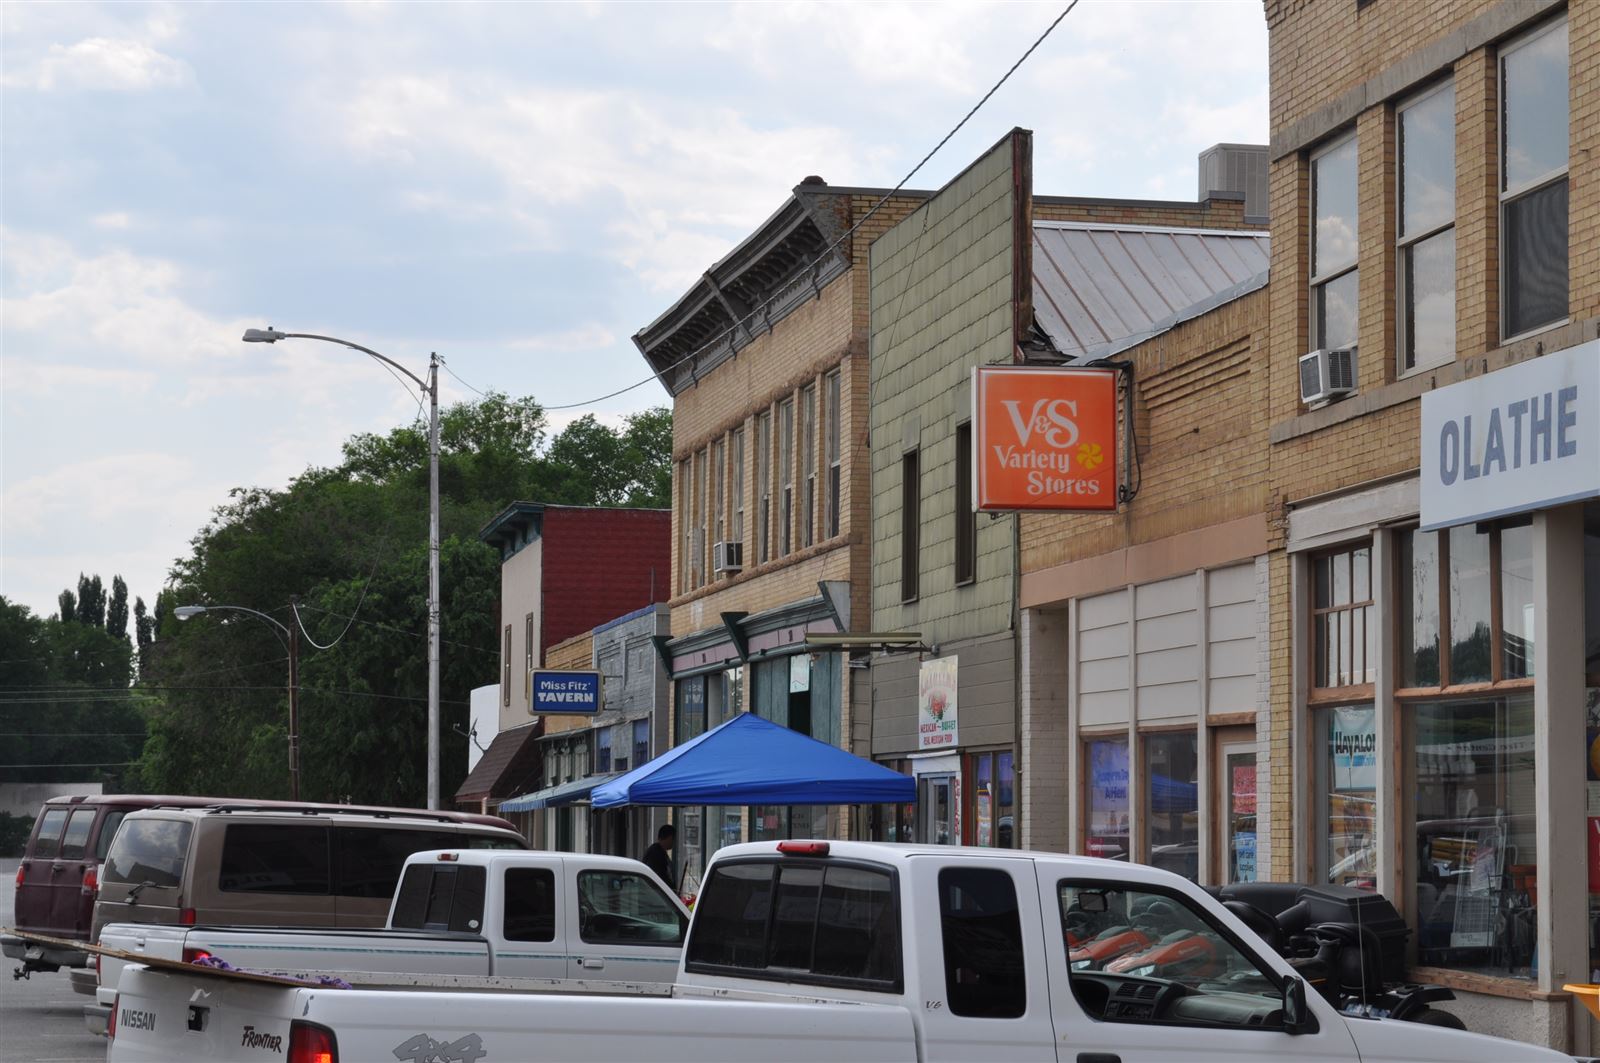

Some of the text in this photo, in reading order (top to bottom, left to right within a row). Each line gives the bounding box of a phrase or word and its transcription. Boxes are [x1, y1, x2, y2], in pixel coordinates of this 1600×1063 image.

[1000, 398, 1079, 449] V&S
[1439, 384, 1578, 487] OLATHE
[992, 444, 1071, 474] Variety
[1026, 470, 1100, 496] Stores
[537, 692, 594, 703] TAVERN
[540, 681, 567, 690] Miss
[941, 720, 956, 731] BUFFET
[120, 1009, 156, 1031] NISSAN
